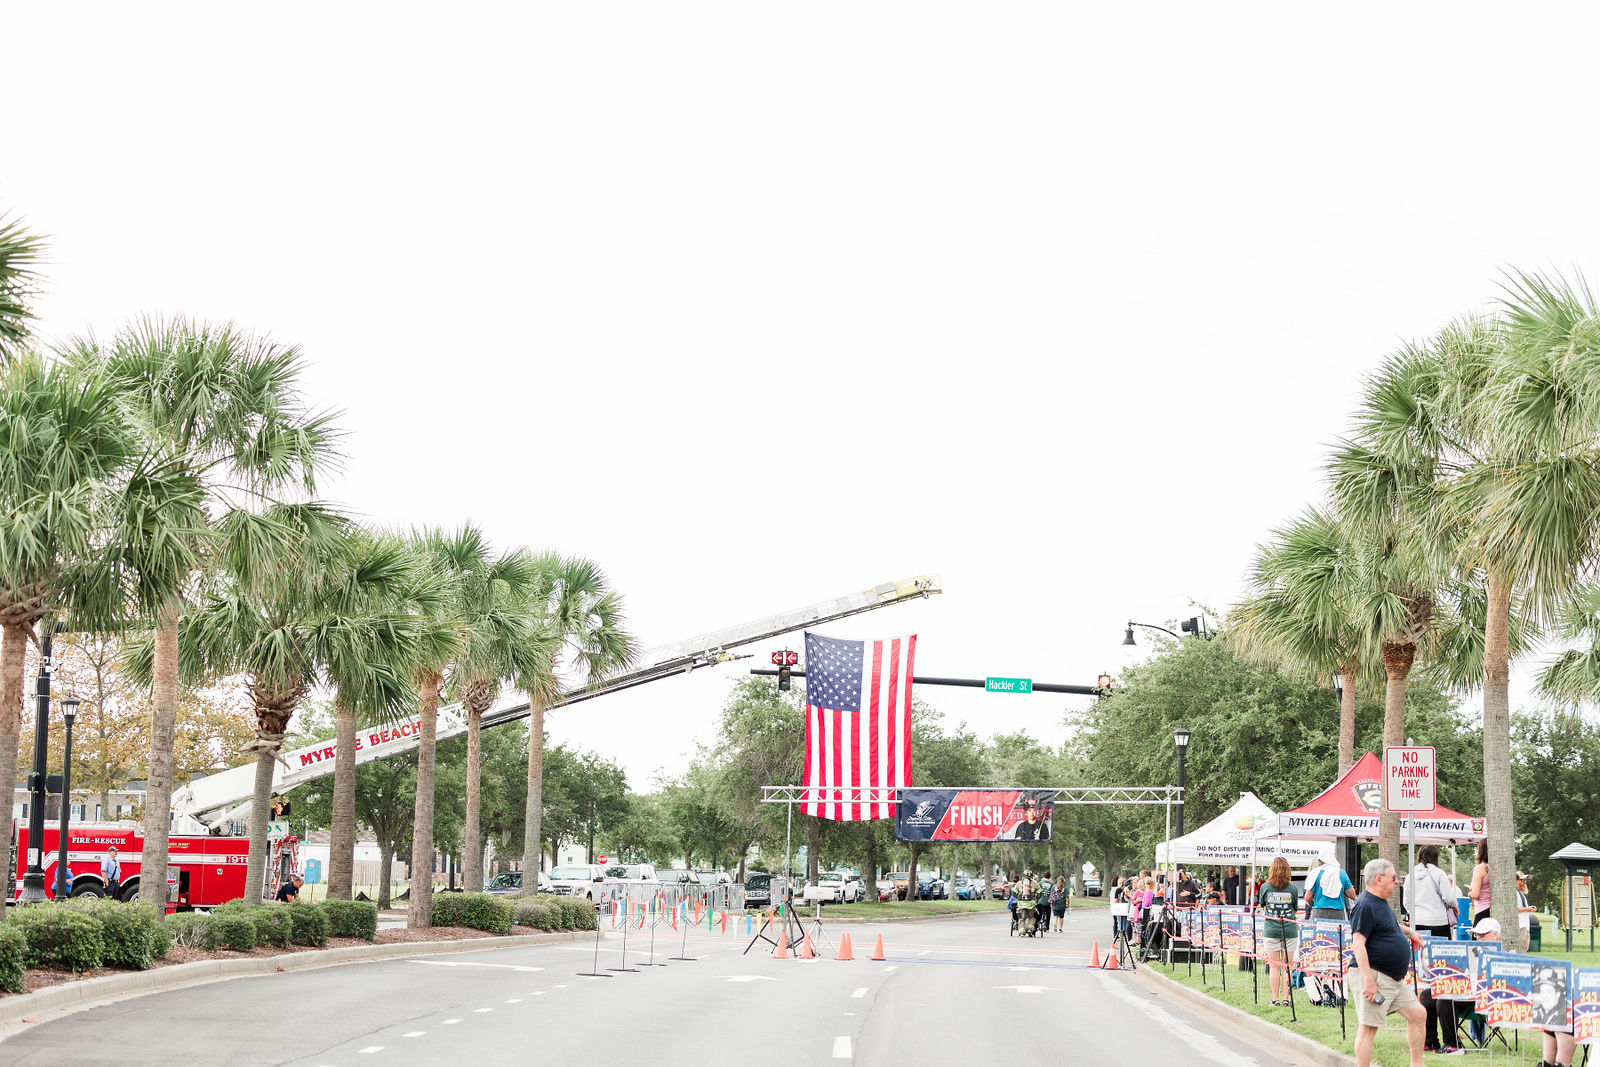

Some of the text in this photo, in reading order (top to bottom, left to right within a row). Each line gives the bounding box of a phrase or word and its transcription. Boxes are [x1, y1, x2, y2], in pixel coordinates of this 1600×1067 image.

[989, 680, 1027, 690] Hackler St
[300, 721, 420, 766] MYRE BEACH
[1402, 752, 1418, 763] NO
[1392, 766, 1429, 778] PARKING
[1401, 779, 1419, 788] ANY
[1401, 789, 1421, 798] TIME
[950, 806, 1002, 825] FINISH
[1288, 818, 1330, 827] MYRTLE
[1333, 819, 1364, 828] BEACH
[1400, 820, 1466, 830] EARTMENT
[1433, 959, 1446, 968] 343
[1435, 979, 1470, 995] FDNY
[1492, 979, 1506, 990] 343
[1580, 992, 1597, 1002] 343
[1493, 1003, 1532, 1023] FDNY
[1581, 1018, 1600, 1038] FD
